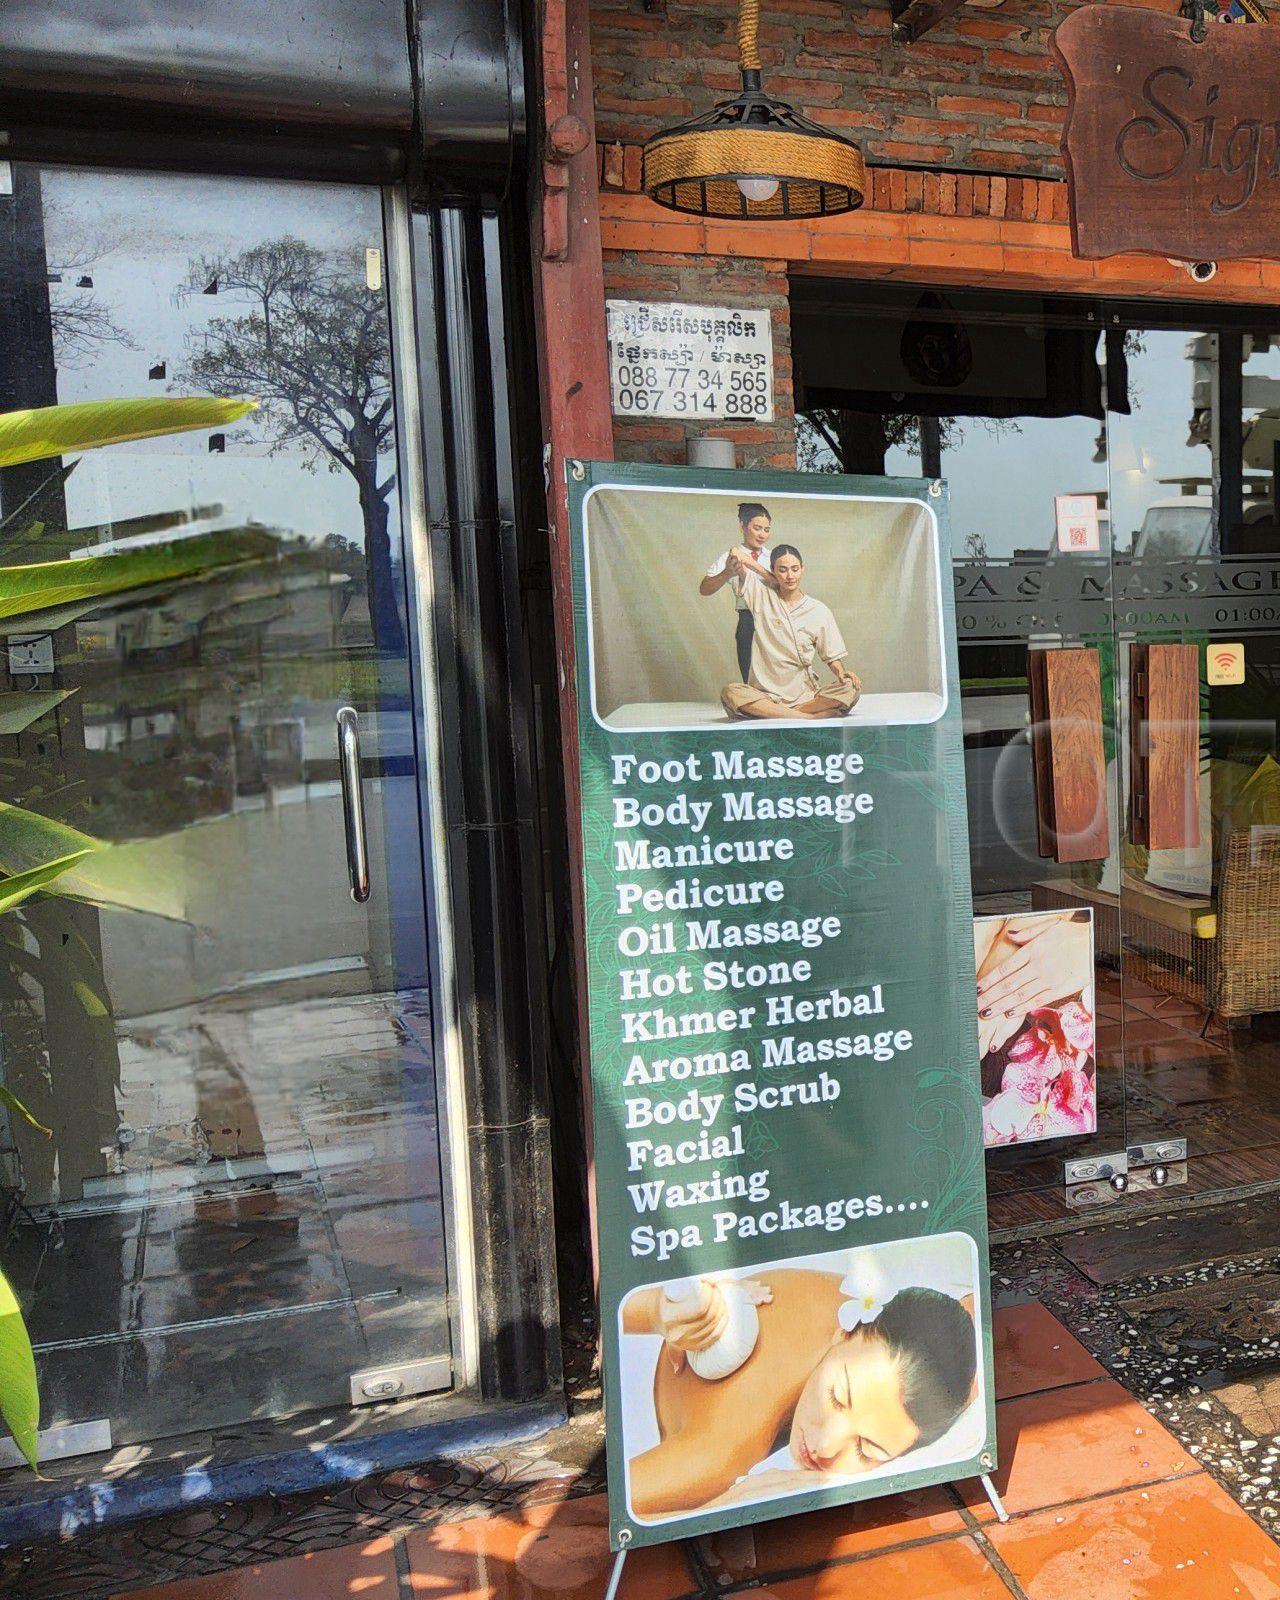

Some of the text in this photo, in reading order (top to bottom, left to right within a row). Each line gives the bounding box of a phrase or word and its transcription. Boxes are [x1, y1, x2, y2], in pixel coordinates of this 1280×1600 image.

[618, 365, 767, 393] 088 77 34 565
[619, 389, 768, 415] 067 314 888
[1016, 570, 1043, 596] &
[611, 750, 864, 785] Foot Massage
[612, 791, 874, 833] Body Massage
[614, 834, 794, 872] Manicure
[615, 878, 785, 915] Pedicure
[617, 915, 842, 957] Oil Massage
[619, 959, 812, 1001] Hot Stone
[621, 984, 885, 1043] Khmer Herbal
[622, 1028, 913, 1087] Aroma Massage
[624, 1071, 841, 1129] Body Scrub
[626, 1125, 745, 1172] Facial
[627, 1169, 771, 1214] Waxing
[630, 1224, 703, 1261] Spa
